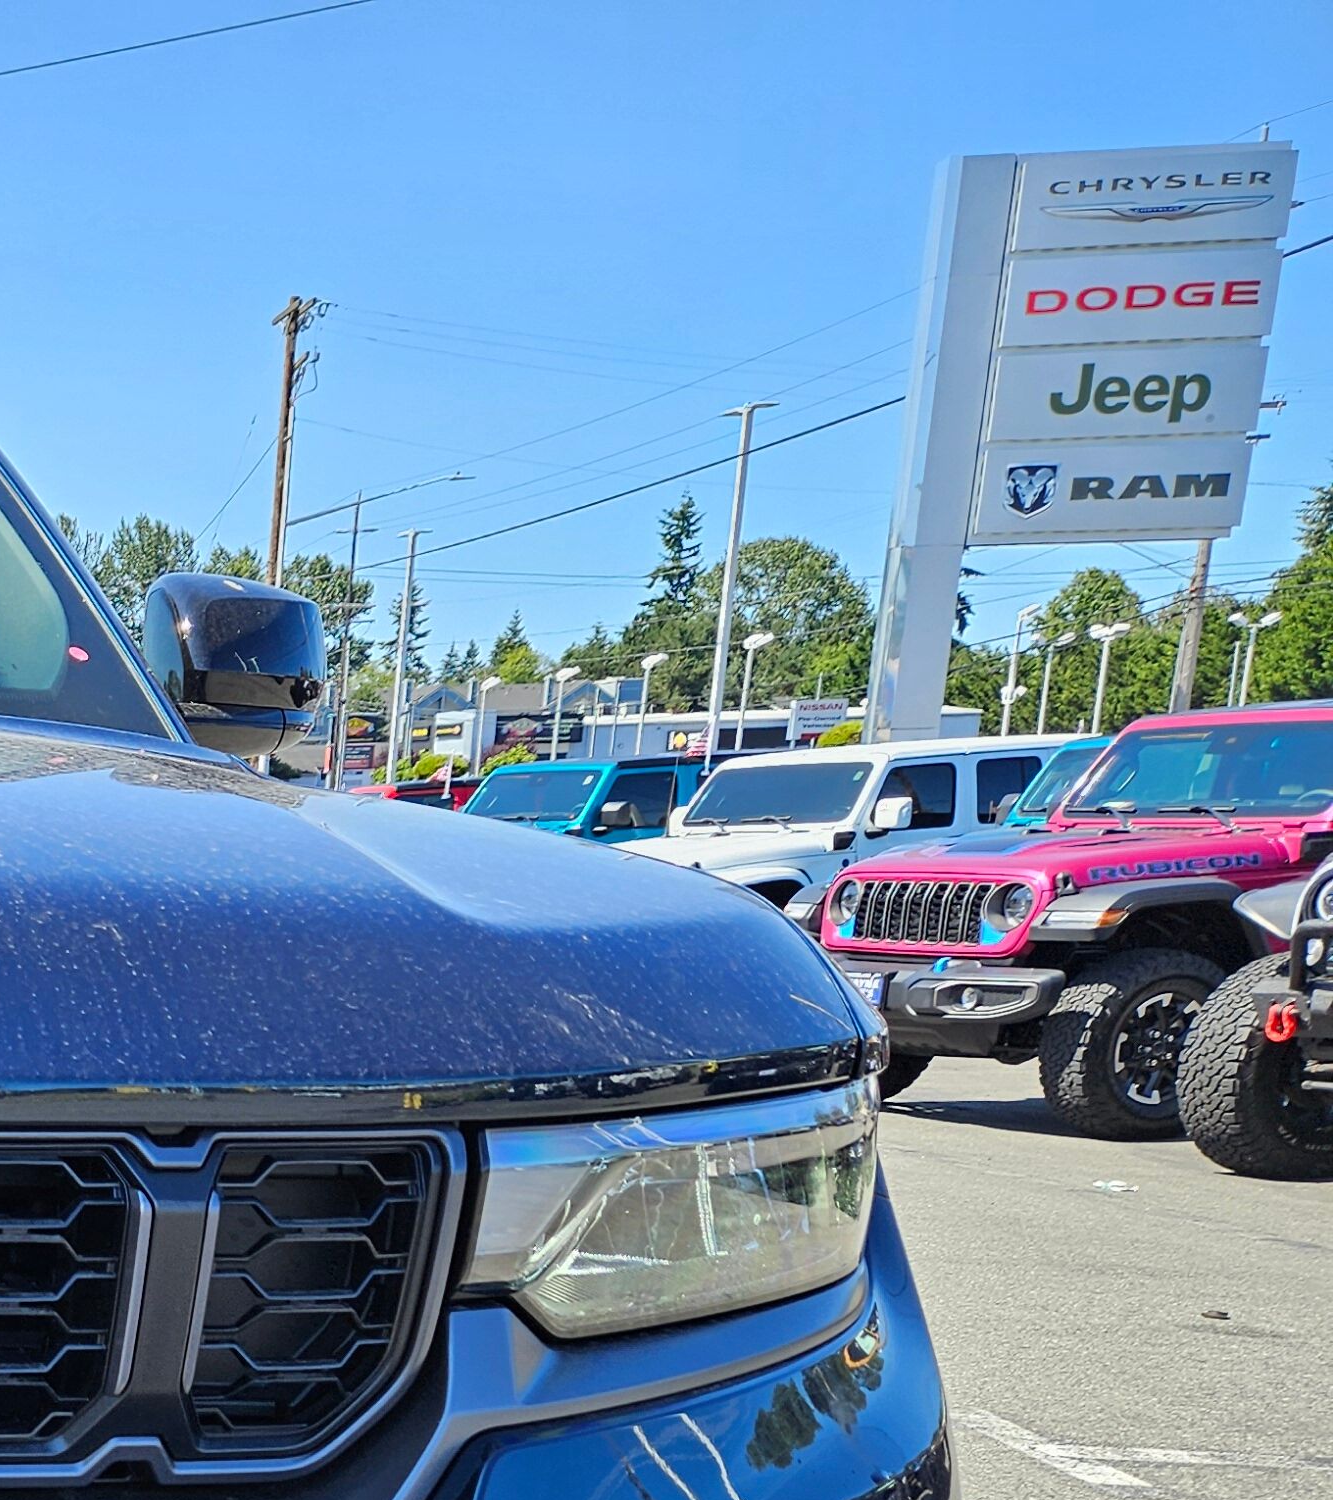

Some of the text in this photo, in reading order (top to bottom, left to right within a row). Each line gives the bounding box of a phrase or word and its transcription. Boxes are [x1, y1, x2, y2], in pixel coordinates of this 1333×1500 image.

[1049, 171, 1271, 195] CHRYSLER
[1025, 280, 1262, 315] DODGE
[1049, 363, 1212, 423] Jeep
[1069, 473, 1232, 501] RAM
[799, 703, 843, 711] NISSAN
[1088, 853, 1261, 881] RUBICON
